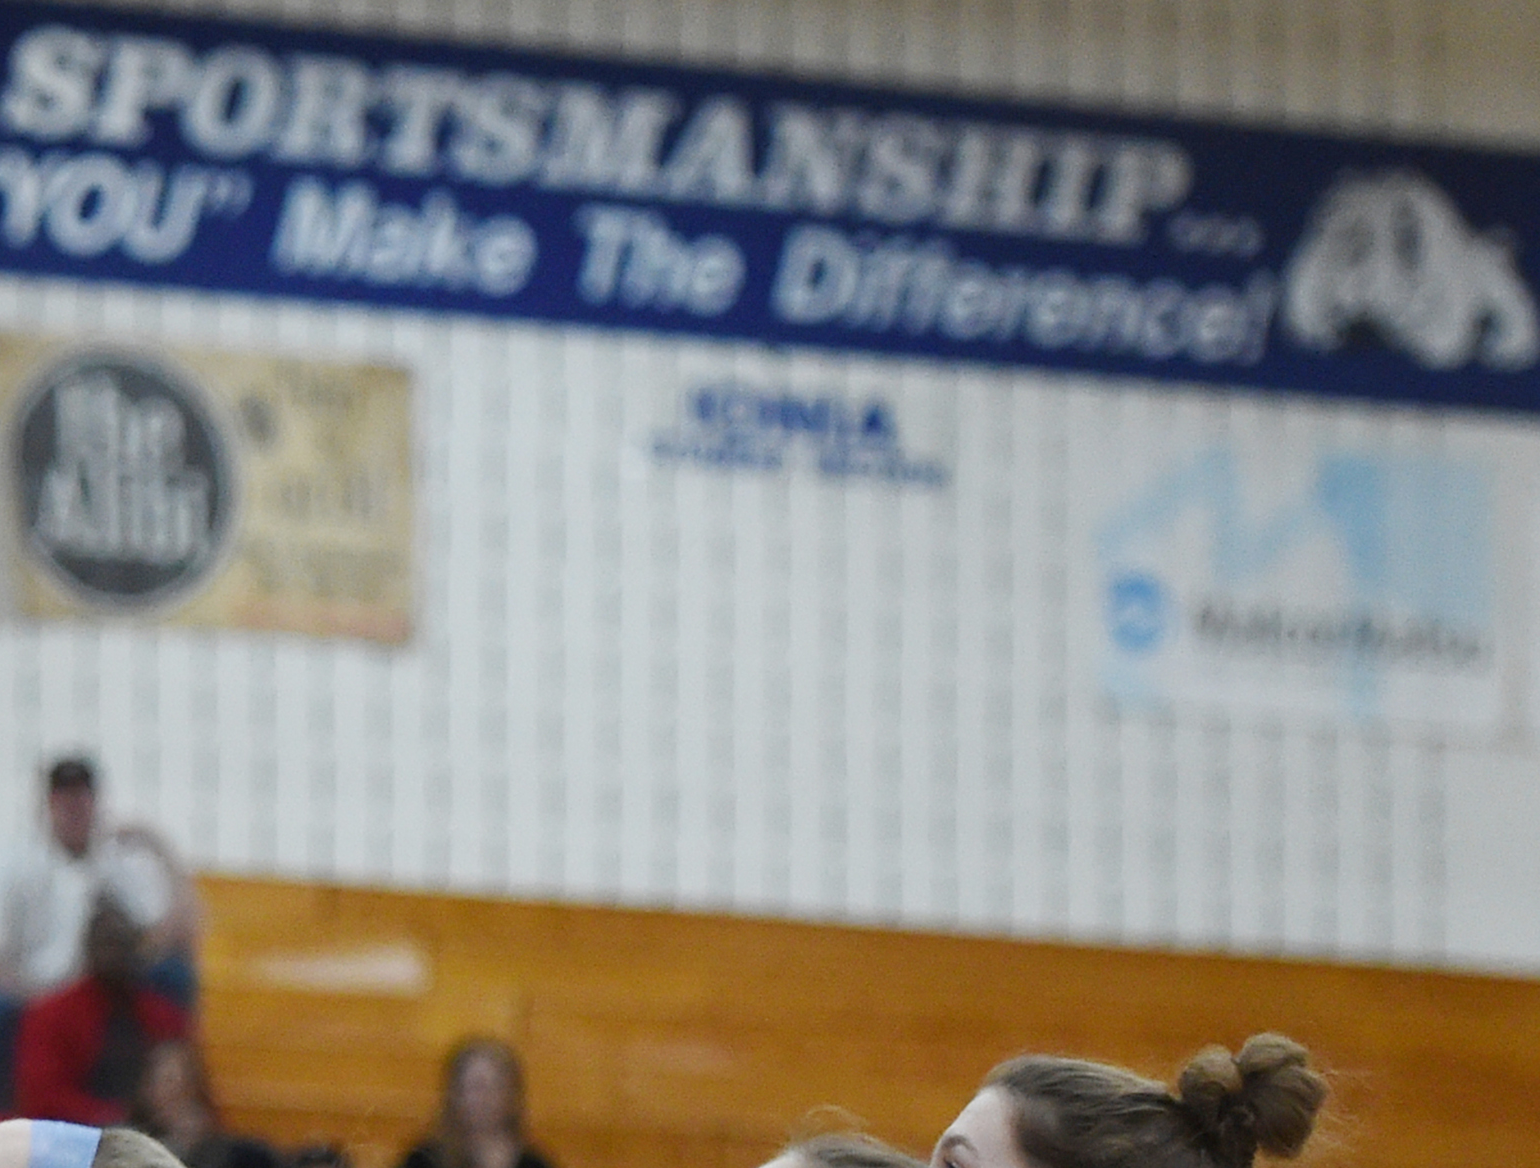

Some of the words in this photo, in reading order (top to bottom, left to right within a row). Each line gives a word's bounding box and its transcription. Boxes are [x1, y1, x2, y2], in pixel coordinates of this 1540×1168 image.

[272, 174, 540, 299] Make
[574, 203, 750, 318] The
[768, 222, 1276, 364] Difference!
